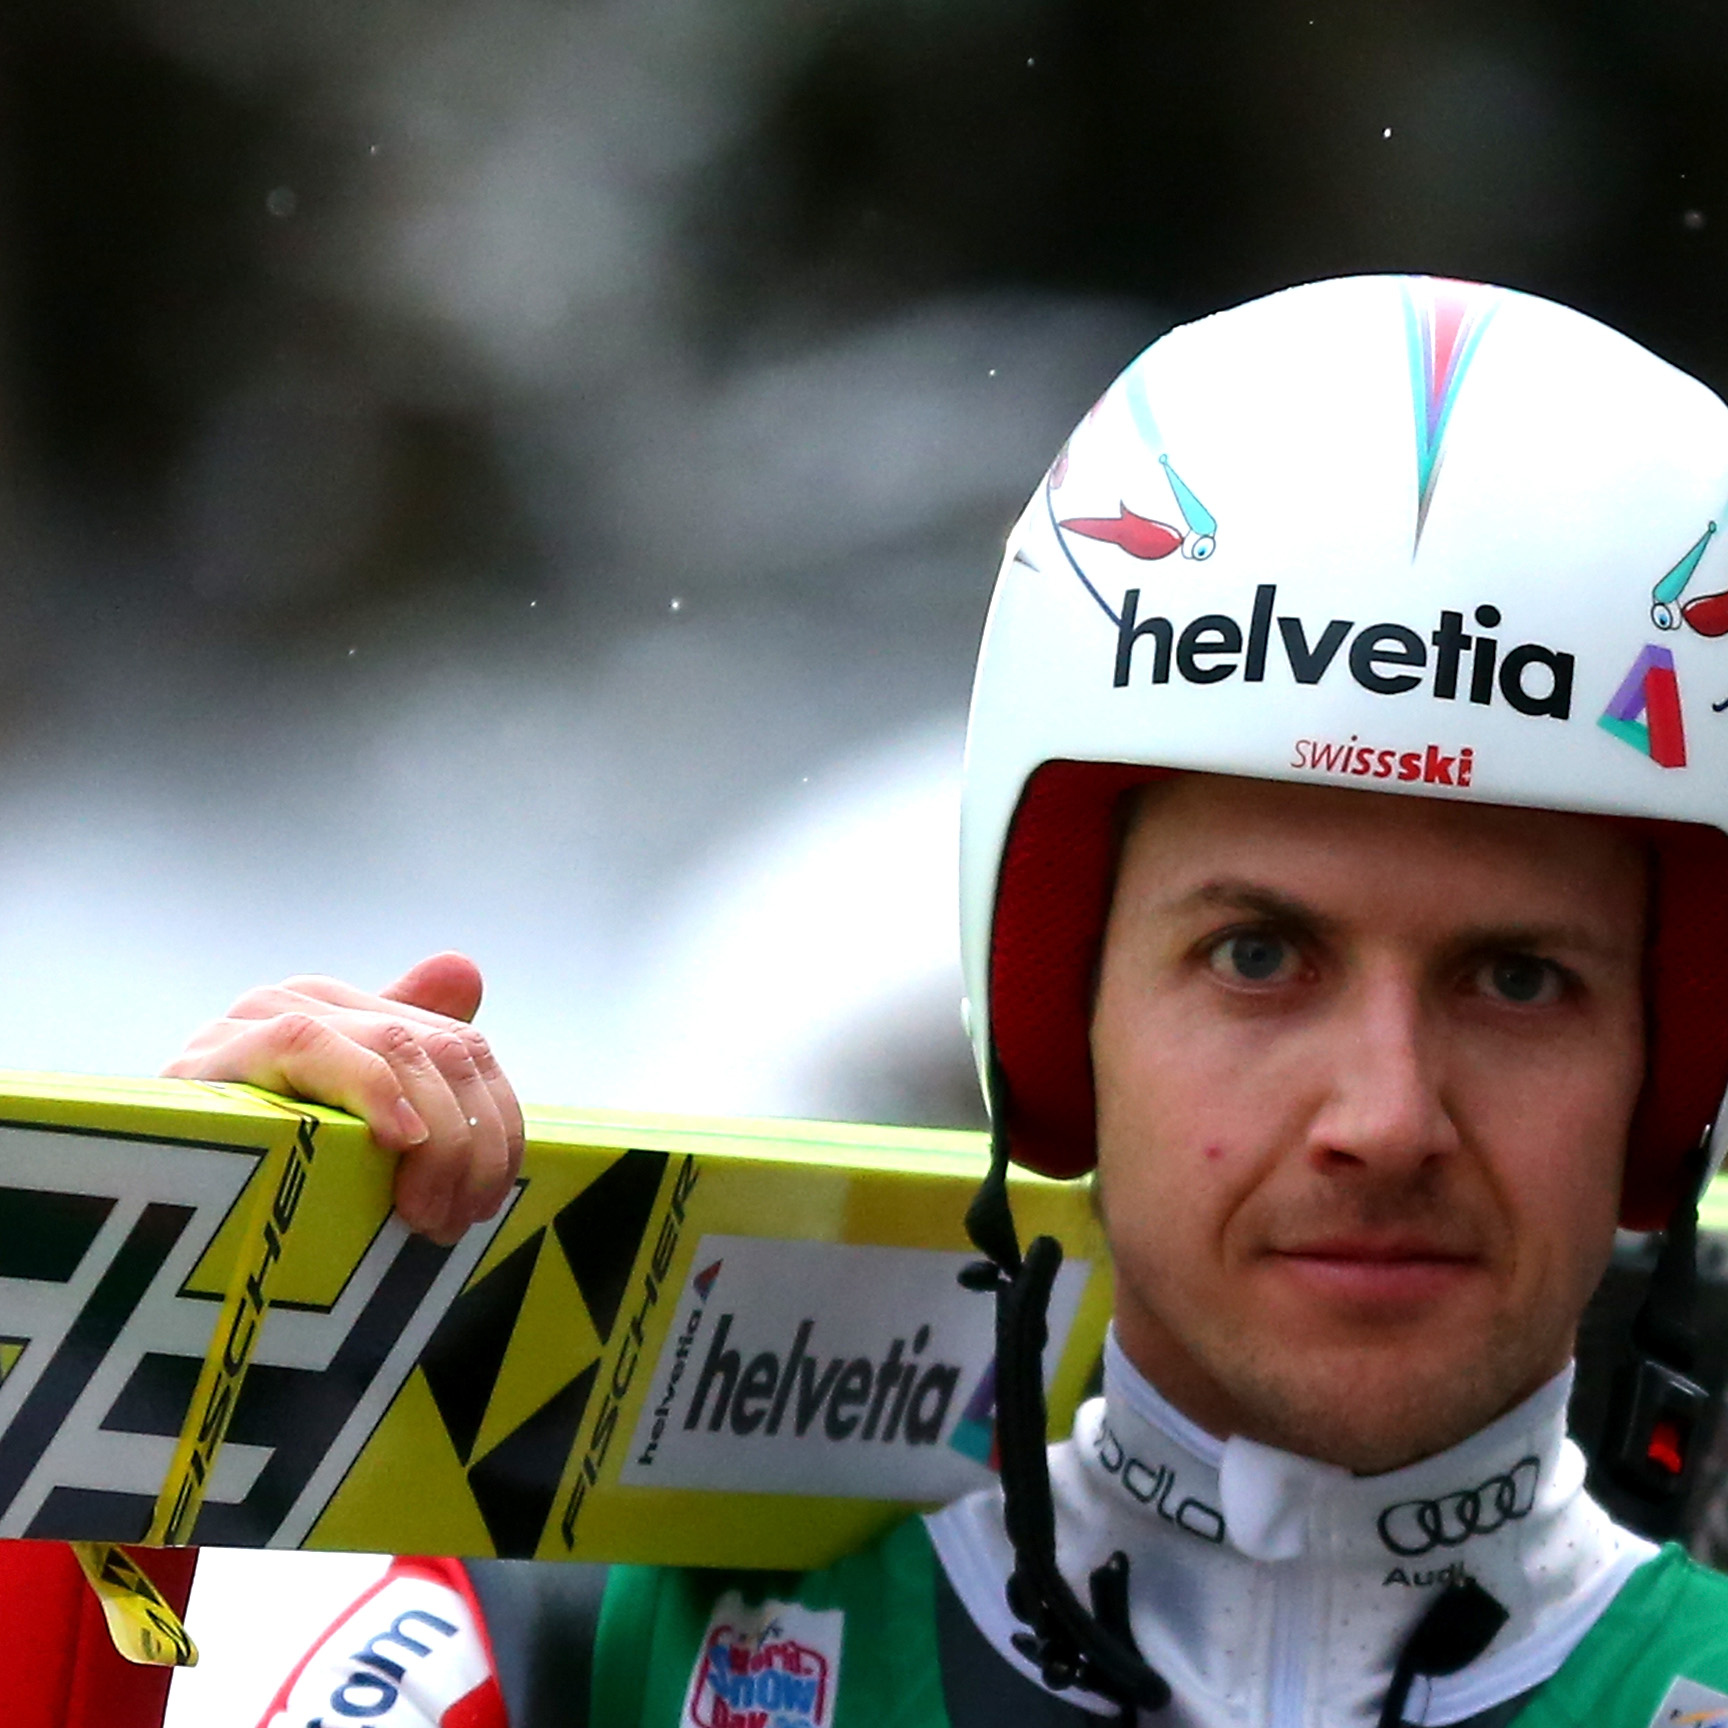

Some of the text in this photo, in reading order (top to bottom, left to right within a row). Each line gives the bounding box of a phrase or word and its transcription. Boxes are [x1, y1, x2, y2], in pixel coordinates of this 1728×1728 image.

[1113, 584, 1576, 720] helvetia
[1290, 735, 1474, 787] swissski
[561, 1152, 700, 1551] FISCHER
[638, 1306, 702, 1467] helvetia
[683, 1313, 962, 1447] helvetia
